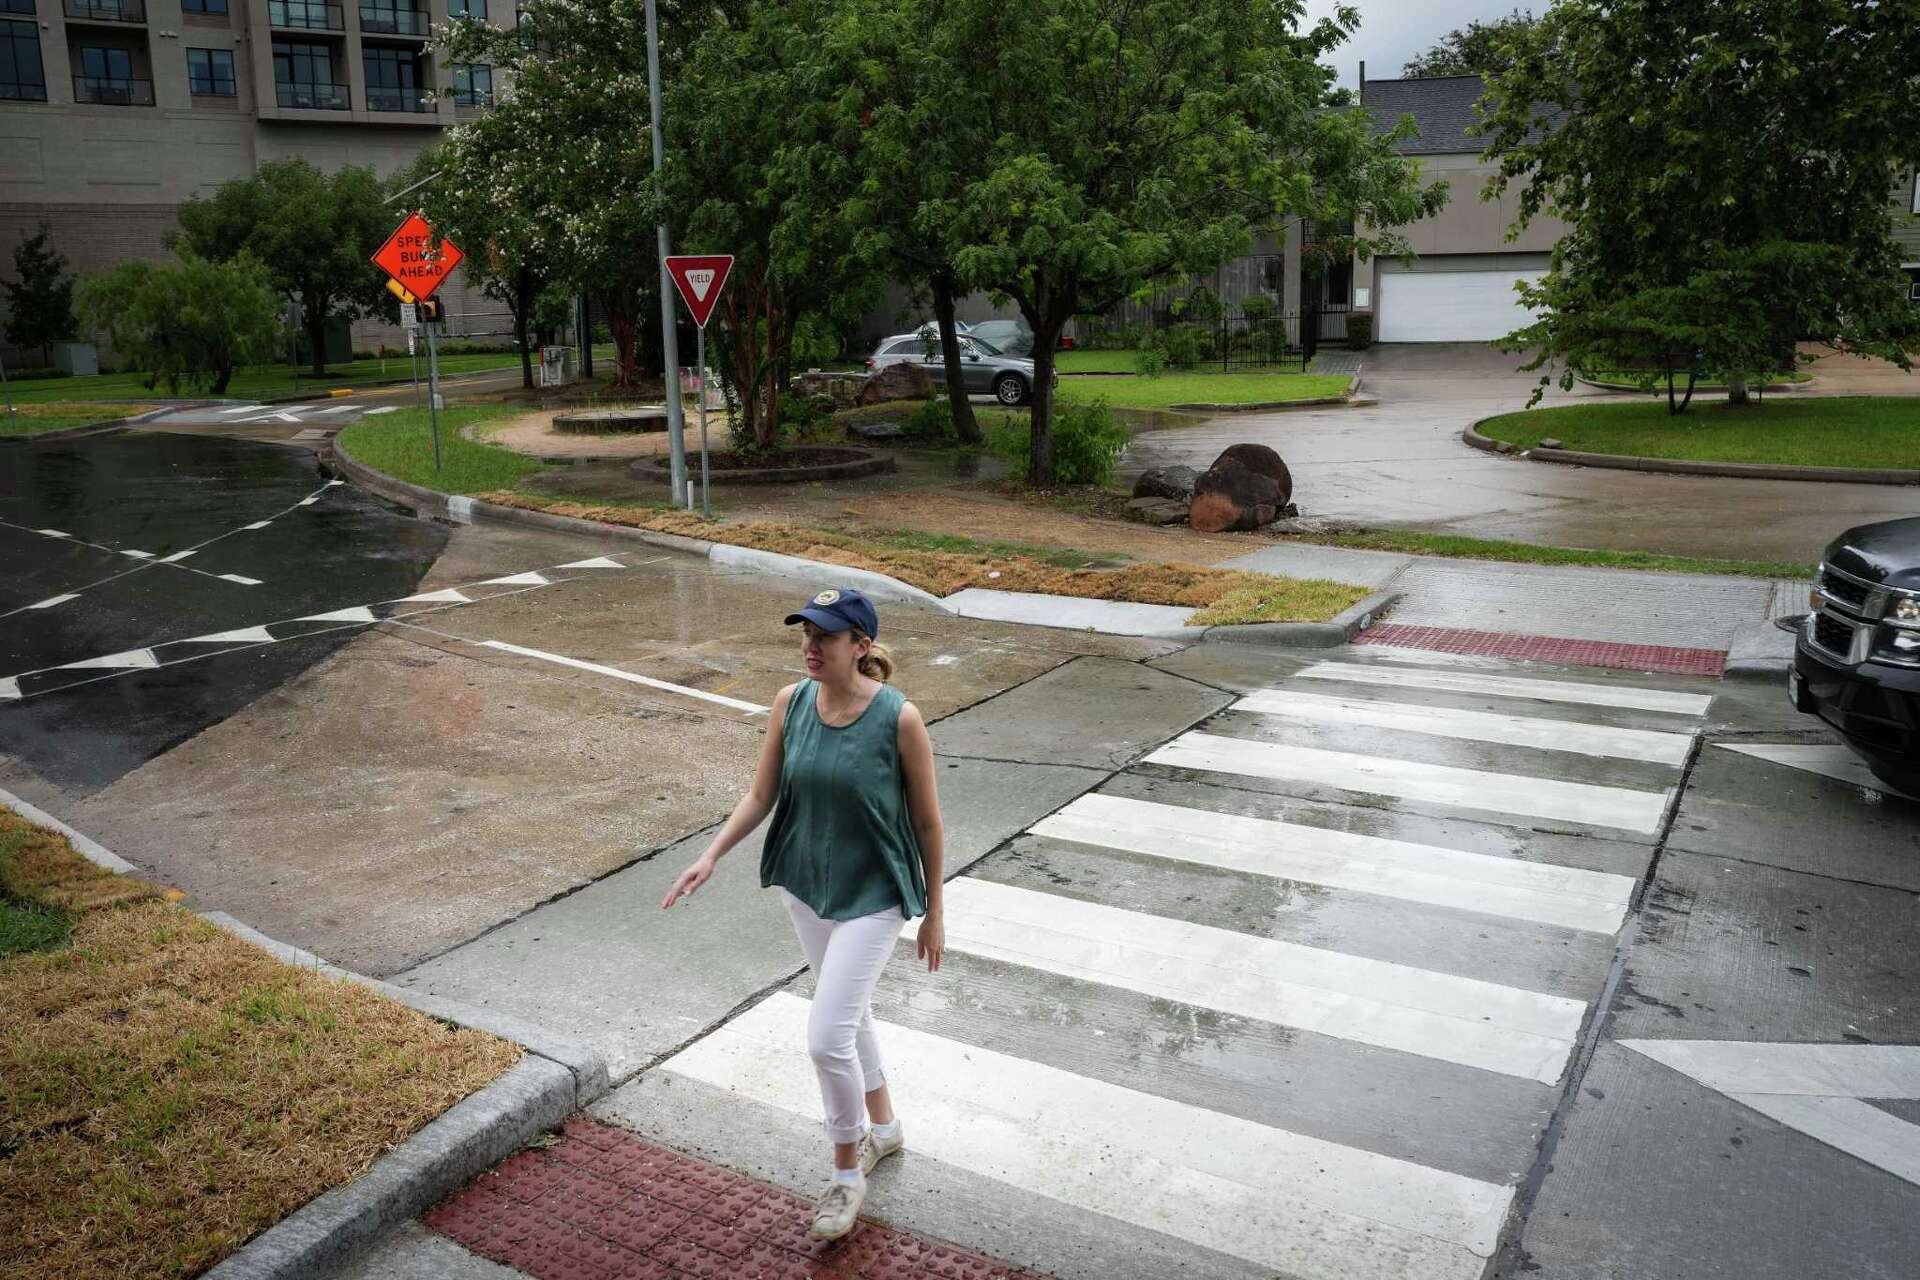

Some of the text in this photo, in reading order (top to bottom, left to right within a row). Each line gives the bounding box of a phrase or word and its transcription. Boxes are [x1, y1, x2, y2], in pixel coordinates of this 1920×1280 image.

[397, 235, 440, 247] SPE
[400, 251, 440, 263] BUM
[399, 265, 442, 277] AHEAD
[690, 273, 710, 283] YIELD
